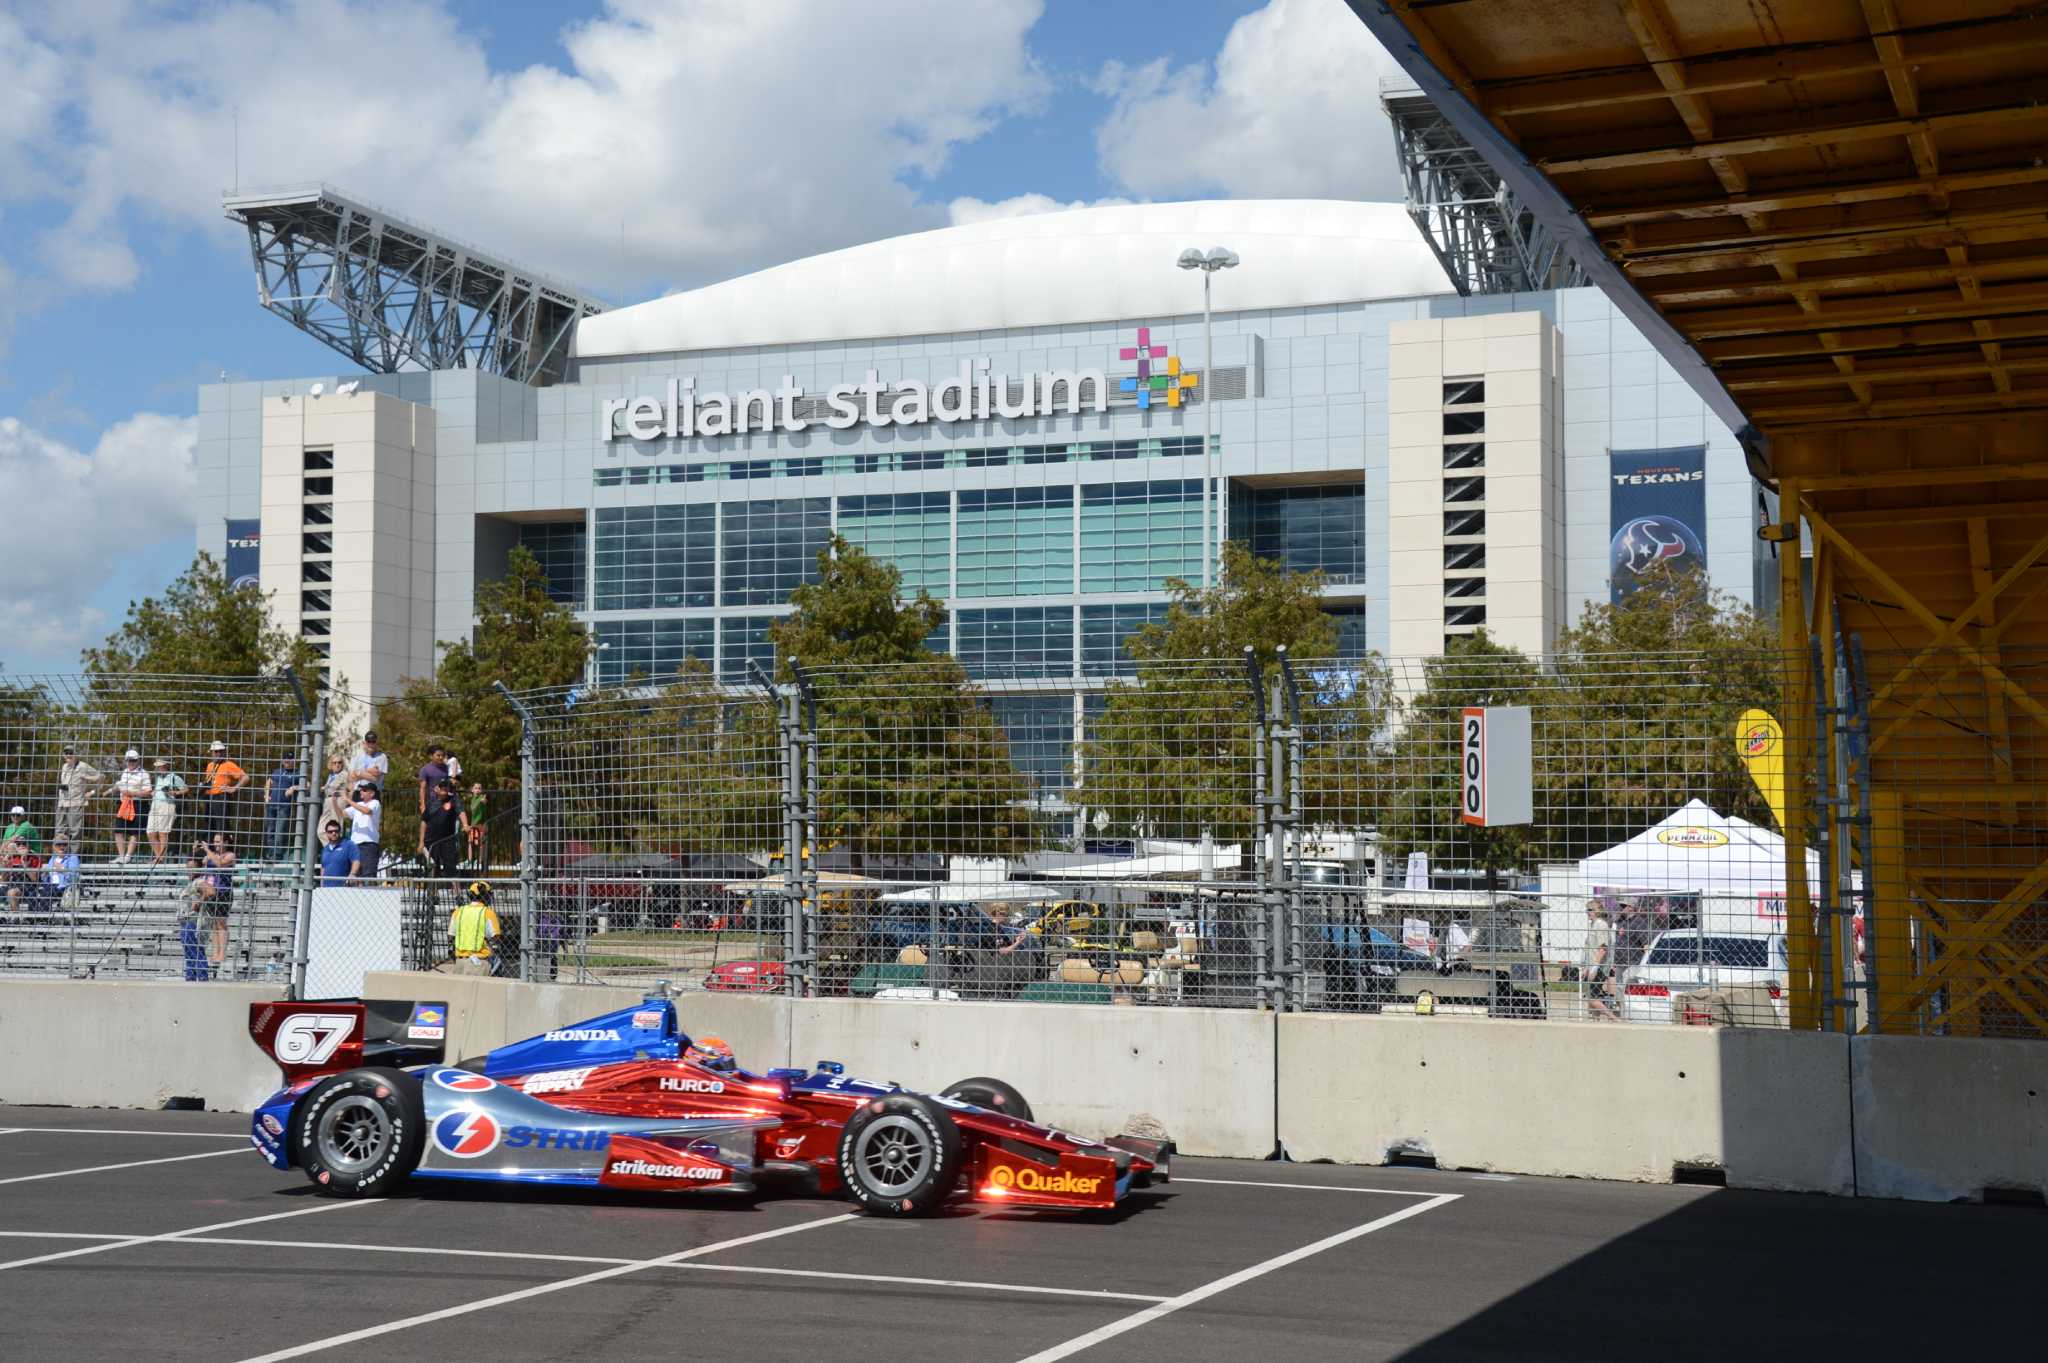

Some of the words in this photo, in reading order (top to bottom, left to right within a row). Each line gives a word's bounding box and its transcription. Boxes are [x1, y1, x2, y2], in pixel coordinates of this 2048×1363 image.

[603, 375, 805, 442] reliant
[825, 357, 1108, 429] stadium
[1613, 470, 1704, 485] TEXANS
[1466, 719, 1480, 813] 200
[275, 1013, 357, 1064] 67
[543, 1030, 621, 1042] HONDA
[523, 1079, 585, 1094] SUPPLY
[660, 1077, 725, 1093] HURCO
[611, 1160, 723, 1180] strikeusa.com
[1017, 1168, 1101, 1194] Quaker
